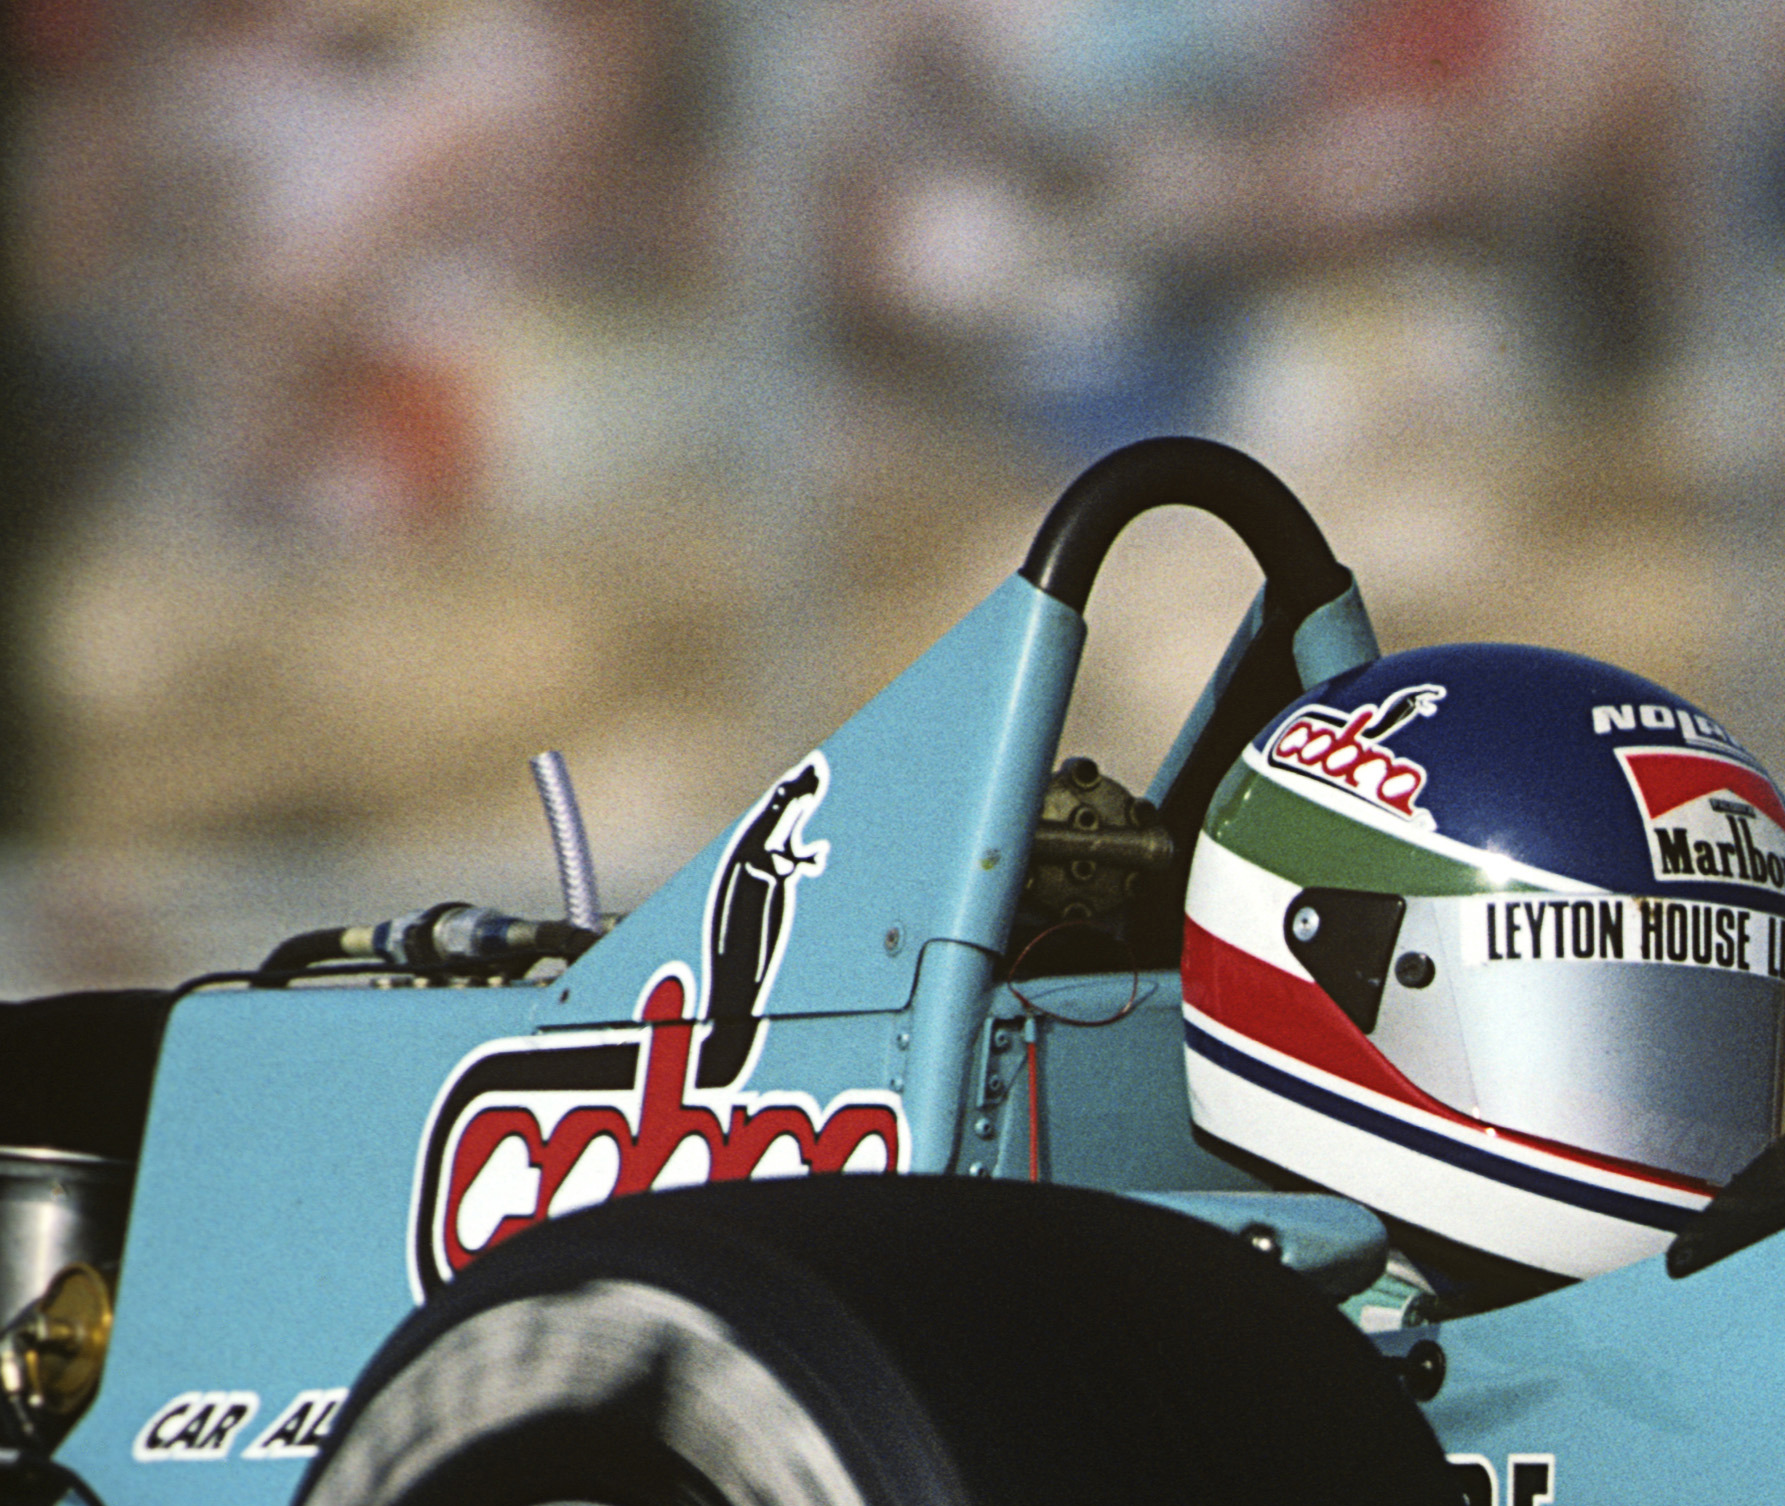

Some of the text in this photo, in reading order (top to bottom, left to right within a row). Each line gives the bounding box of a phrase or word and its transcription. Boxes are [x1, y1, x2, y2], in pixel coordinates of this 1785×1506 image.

[1275, 710, 1422, 817] cobra
[1487, 900, 1624, 961] LEYTON
[1640, 901, 1751, 971] HOUSE
[139, 1397, 254, 1455] CAR
